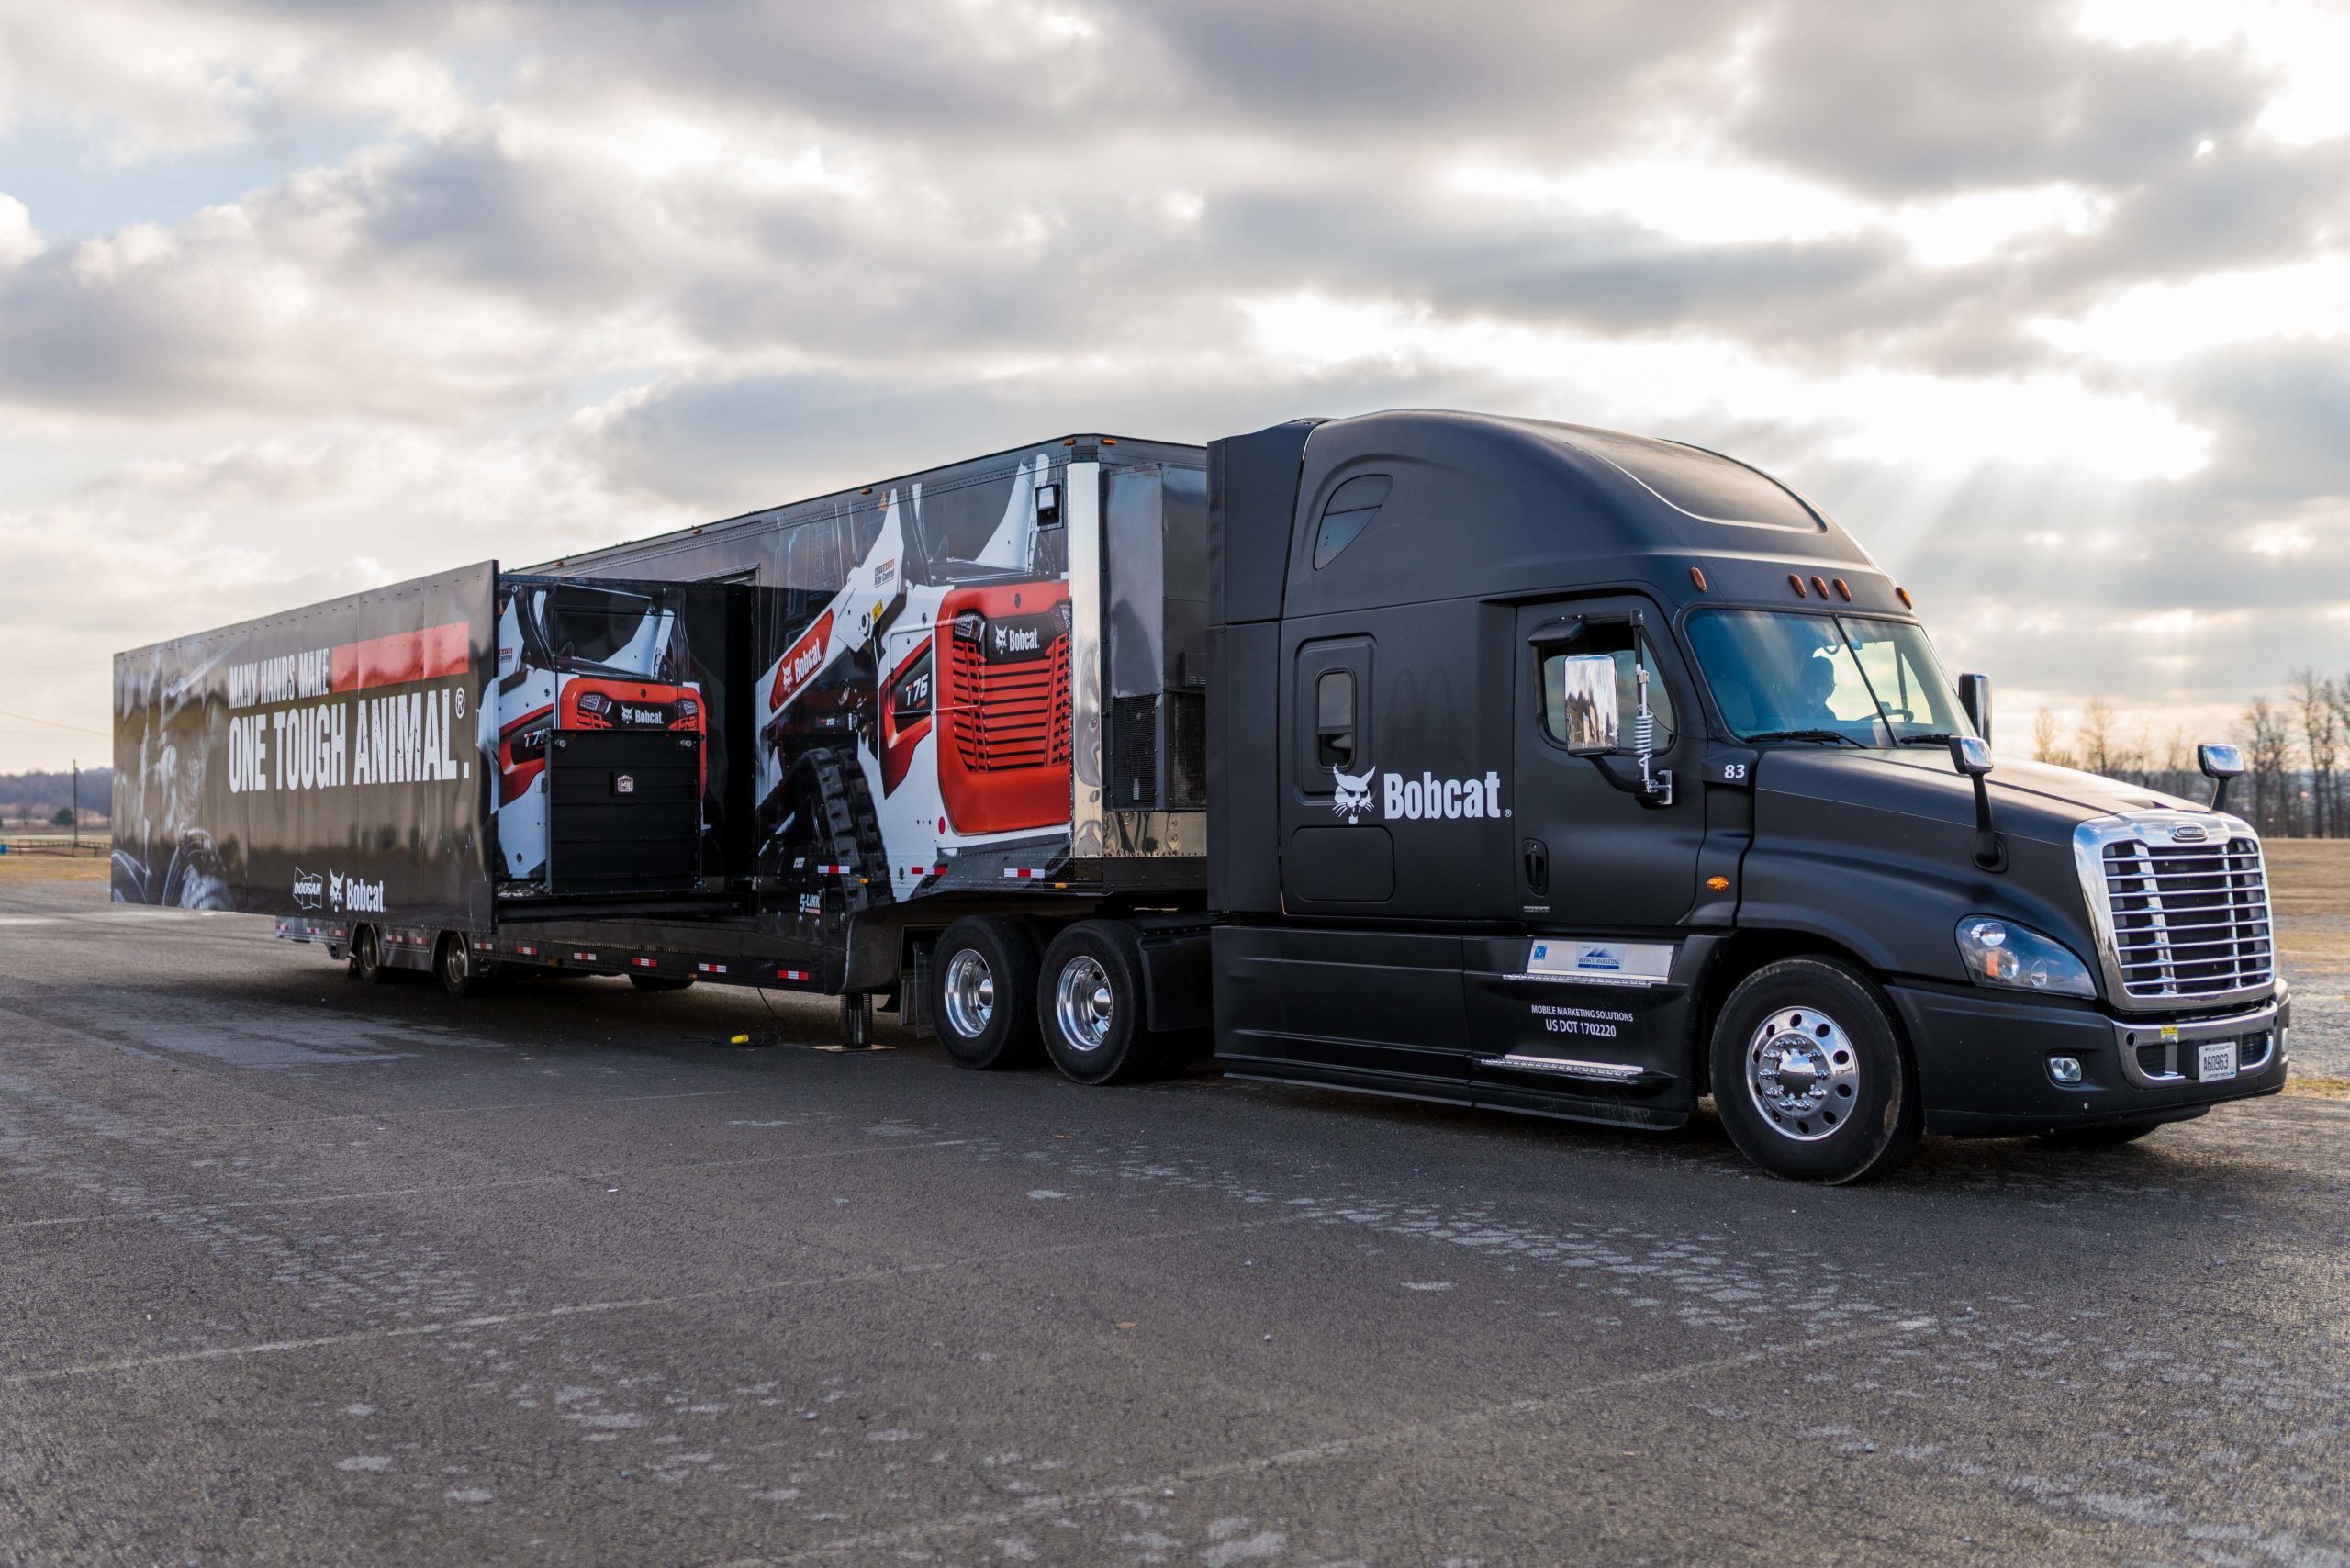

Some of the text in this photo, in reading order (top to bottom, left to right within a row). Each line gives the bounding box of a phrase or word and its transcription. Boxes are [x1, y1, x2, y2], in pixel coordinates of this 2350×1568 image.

[1009, 628, 1038, 652] Bobcat
[795, 637, 821, 683] Bobcat
[229, 648, 329, 710] MANY HANDS MAKE
[905, 674, 929, 706] T76
[635, 709, 662, 724] Bobcat
[229, 714, 266, 793] ONE
[274, 703, 346, 790] TOUGH
[1724, 764, 1745, 779] 83
[294, 878, 384, 913] DOOSAN Bobcat
[799, 893, 821, 913] 5-LINK
[1531, 1005, 1633, 1022] MOBILE MARKETING SOLUTIONS
[1545, 1019, 1617, 1037] US DOT 1702220
